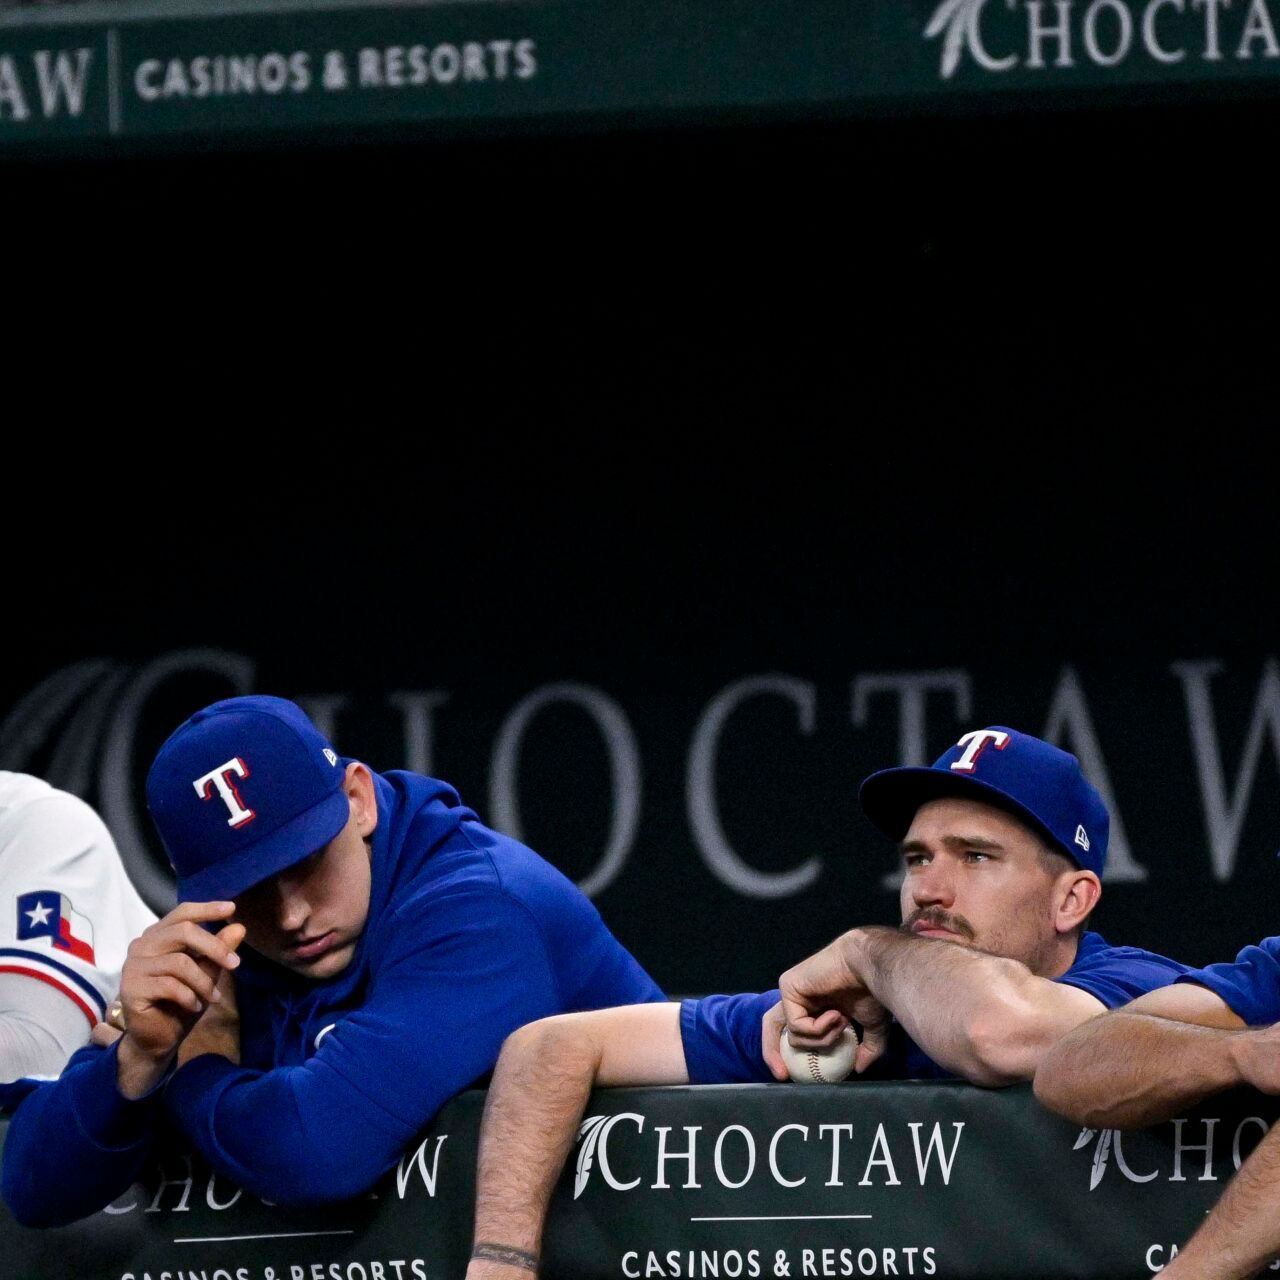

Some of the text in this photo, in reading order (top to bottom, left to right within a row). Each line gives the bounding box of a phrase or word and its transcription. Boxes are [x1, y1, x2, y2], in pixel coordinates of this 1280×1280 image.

[134, 51, 311, 101] CASINOS
[322, 50, 348, 90] &
[358, 38, 537, 88] RESORTS
[952, 729, 1011, 774] T
[193, 757, 258, 829] T
[597, 1112, 966, 1192] CHOCTAW
[621, 1246, 938, 1280] CASINOS & RESORTS
